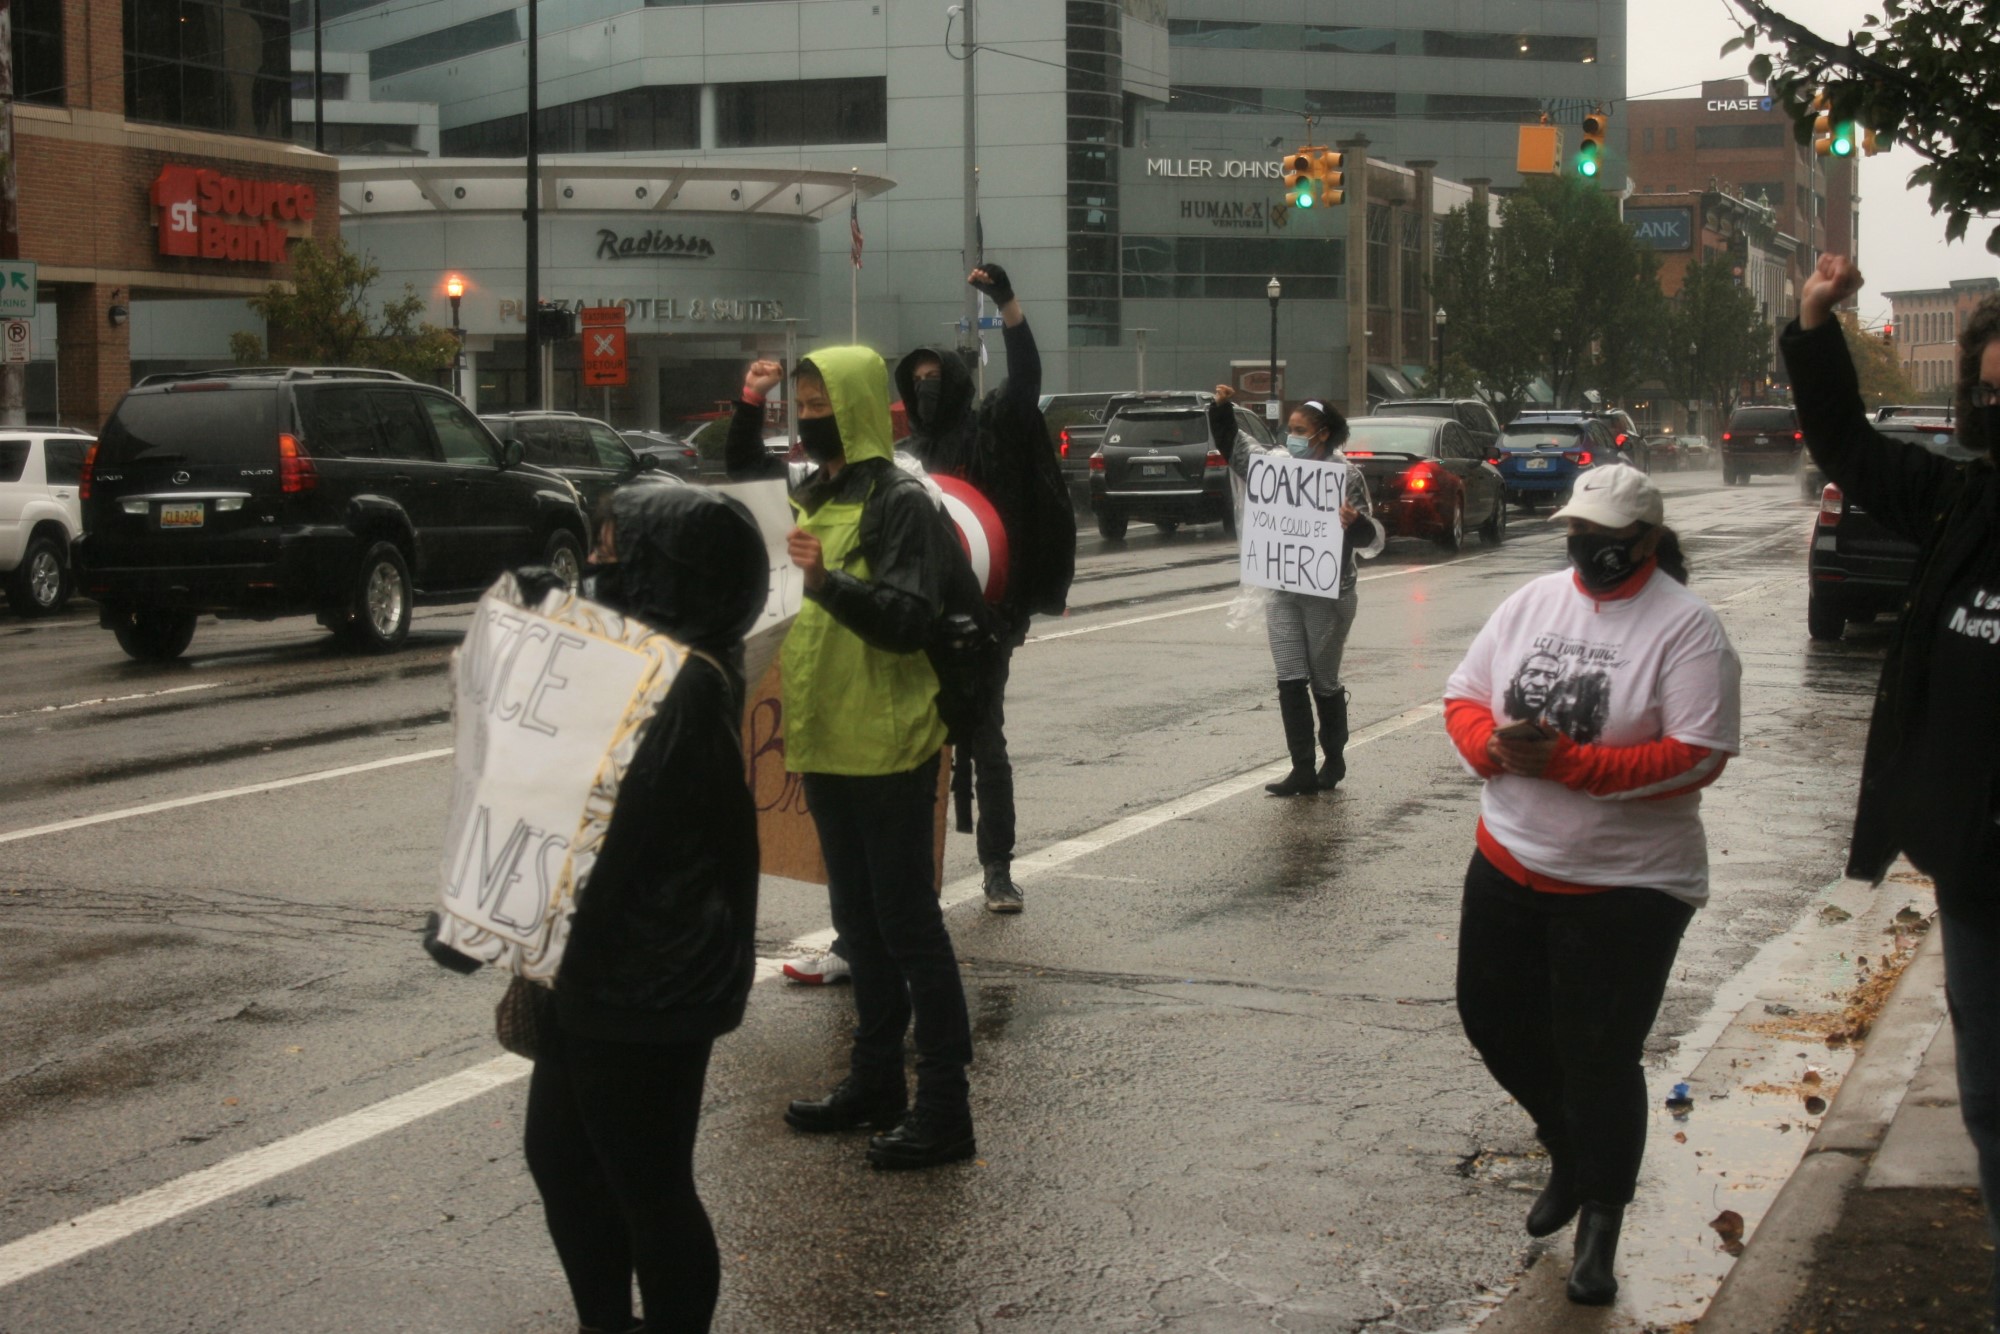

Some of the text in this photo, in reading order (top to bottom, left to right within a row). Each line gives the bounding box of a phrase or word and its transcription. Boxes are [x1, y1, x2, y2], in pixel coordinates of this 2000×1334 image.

[1707, 100, 1758, 111] CHASE
[1147, 158, 1297, 179] MILLER JOHNSO
[198, 169, 317, 222] Source
[1212, 219, 1264, 229] VENTURES
[200, 217, 288, 263] Bank
[596, 228, 715, 260] Radisson
[586, 359, 624, 370] DETOUR
[1246, 459, 1345, 512] COAKLEY
[1252, 510, 1328, 538] YOU COULD BE
[1247, 540, 1338, 591] A HERO
